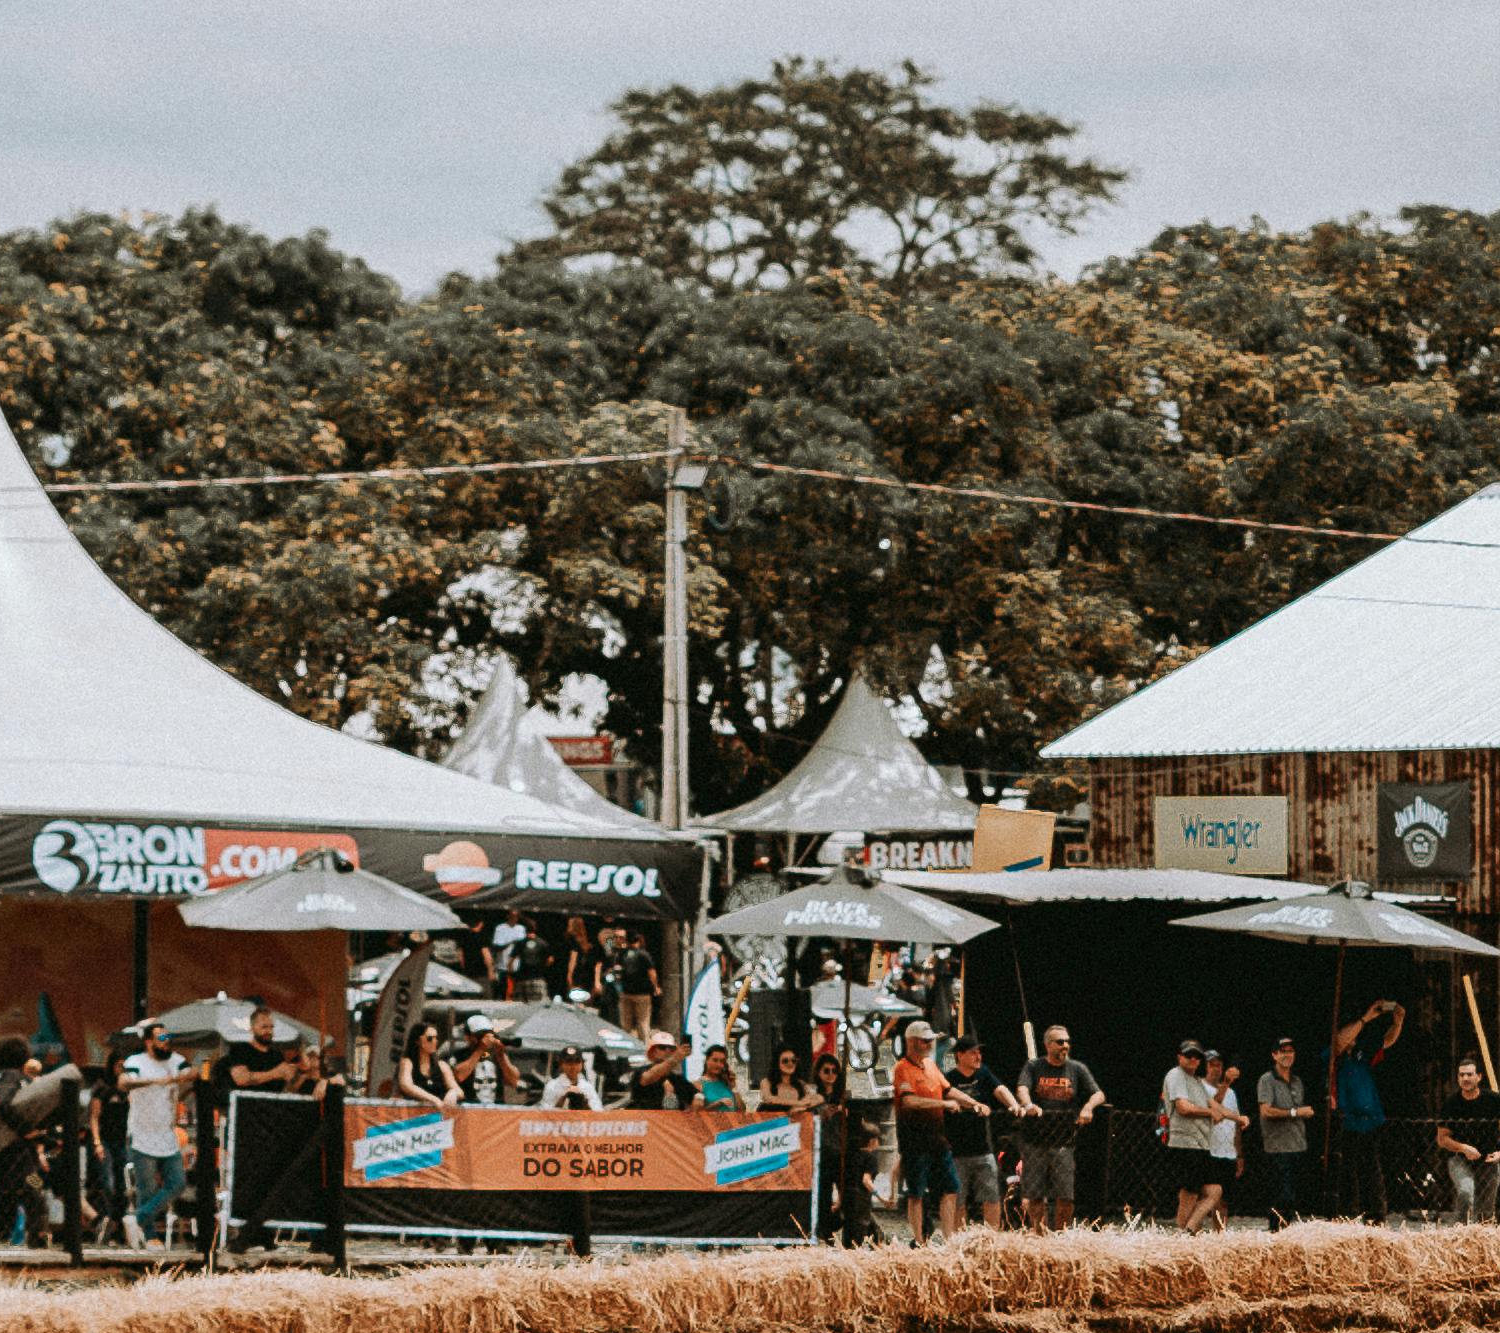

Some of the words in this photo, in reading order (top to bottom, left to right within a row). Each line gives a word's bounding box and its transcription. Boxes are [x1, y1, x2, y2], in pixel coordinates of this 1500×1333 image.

[1180, 813, 1262, 865] Wrangler
[515, 858, 662, 898] REPSOL
[366, 1137, 407, 1161] JOHN
[410, 1132, 444, 1153] MAC
[595, 1143, 645, 1154] MELHOR
[716, 1142, 755, 1165] JOHN
[759, 1132, 791, 1154] MAC
[523, 1158, 561, 1177] DO
[569, 1158, 645, 1178] SABOR
